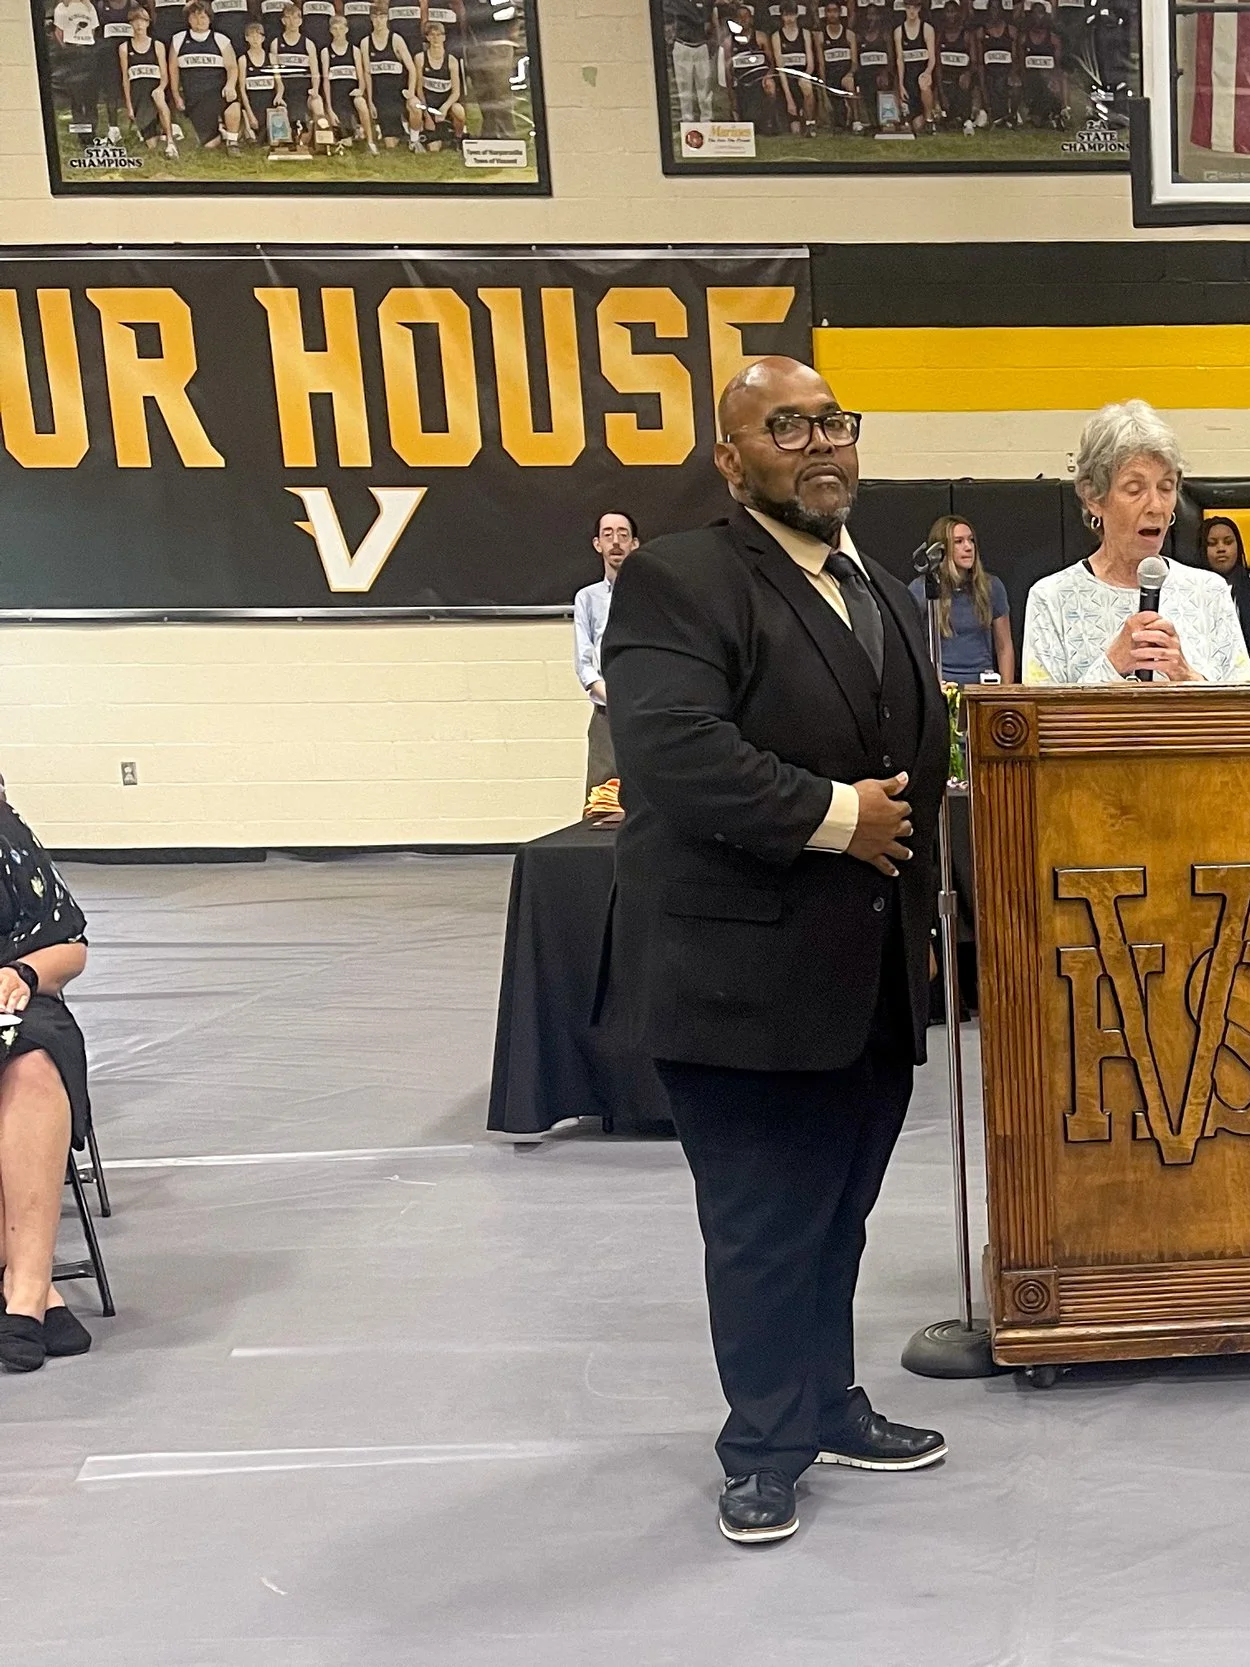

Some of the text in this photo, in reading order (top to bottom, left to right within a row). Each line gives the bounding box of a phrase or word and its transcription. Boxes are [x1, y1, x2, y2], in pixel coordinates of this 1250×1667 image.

[1078, 132, 1116, 141] STATE
[86, 148, 127, 158] STATE
[70, 159, 143, 168] CHAMPIONS
[284, 486, 428, 593] V
